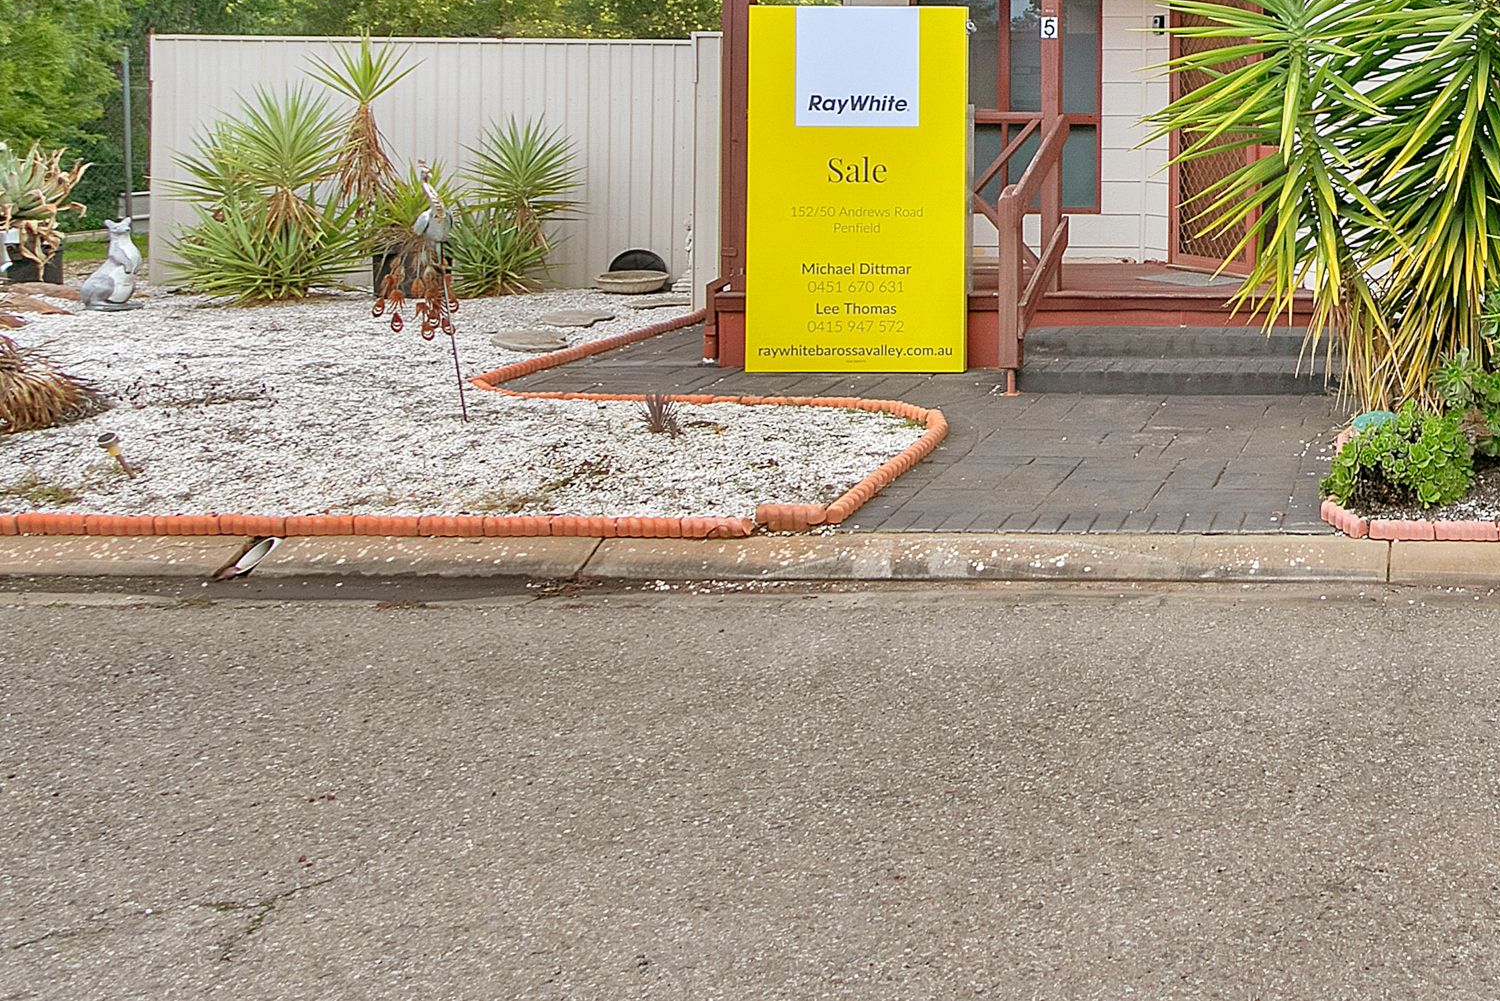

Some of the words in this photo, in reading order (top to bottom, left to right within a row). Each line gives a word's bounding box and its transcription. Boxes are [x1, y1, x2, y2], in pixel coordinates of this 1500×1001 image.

[1044, 18, 1055, 37] 5
[808, 94, 909, 115] RayWhite
[828, 156, 888, 184] Sale
[791, 206, 836, 218] 152/50
[839, 206, 891, 218] Andrews
[894, 206, 924, 218] Road
[833, 222, 881, 234] Penfield
[801, 262, 855, 275] Michael
[859, 262, 912, 275] Dittmar
[807, 281, 843, 293] 0451
[848, 281, 875, 293] 670
[879, 281, 905, 293] 631
[816, 302, 840, 315] Lee
[843, 302, 897, 315] Thomas
[807, 320, 843, 333] 0415
[848, 320, 874, 333] 947
[879, 320, 905, 333] 572
[758, 344, 953, 359] raywhitebarossavalley.com.au
